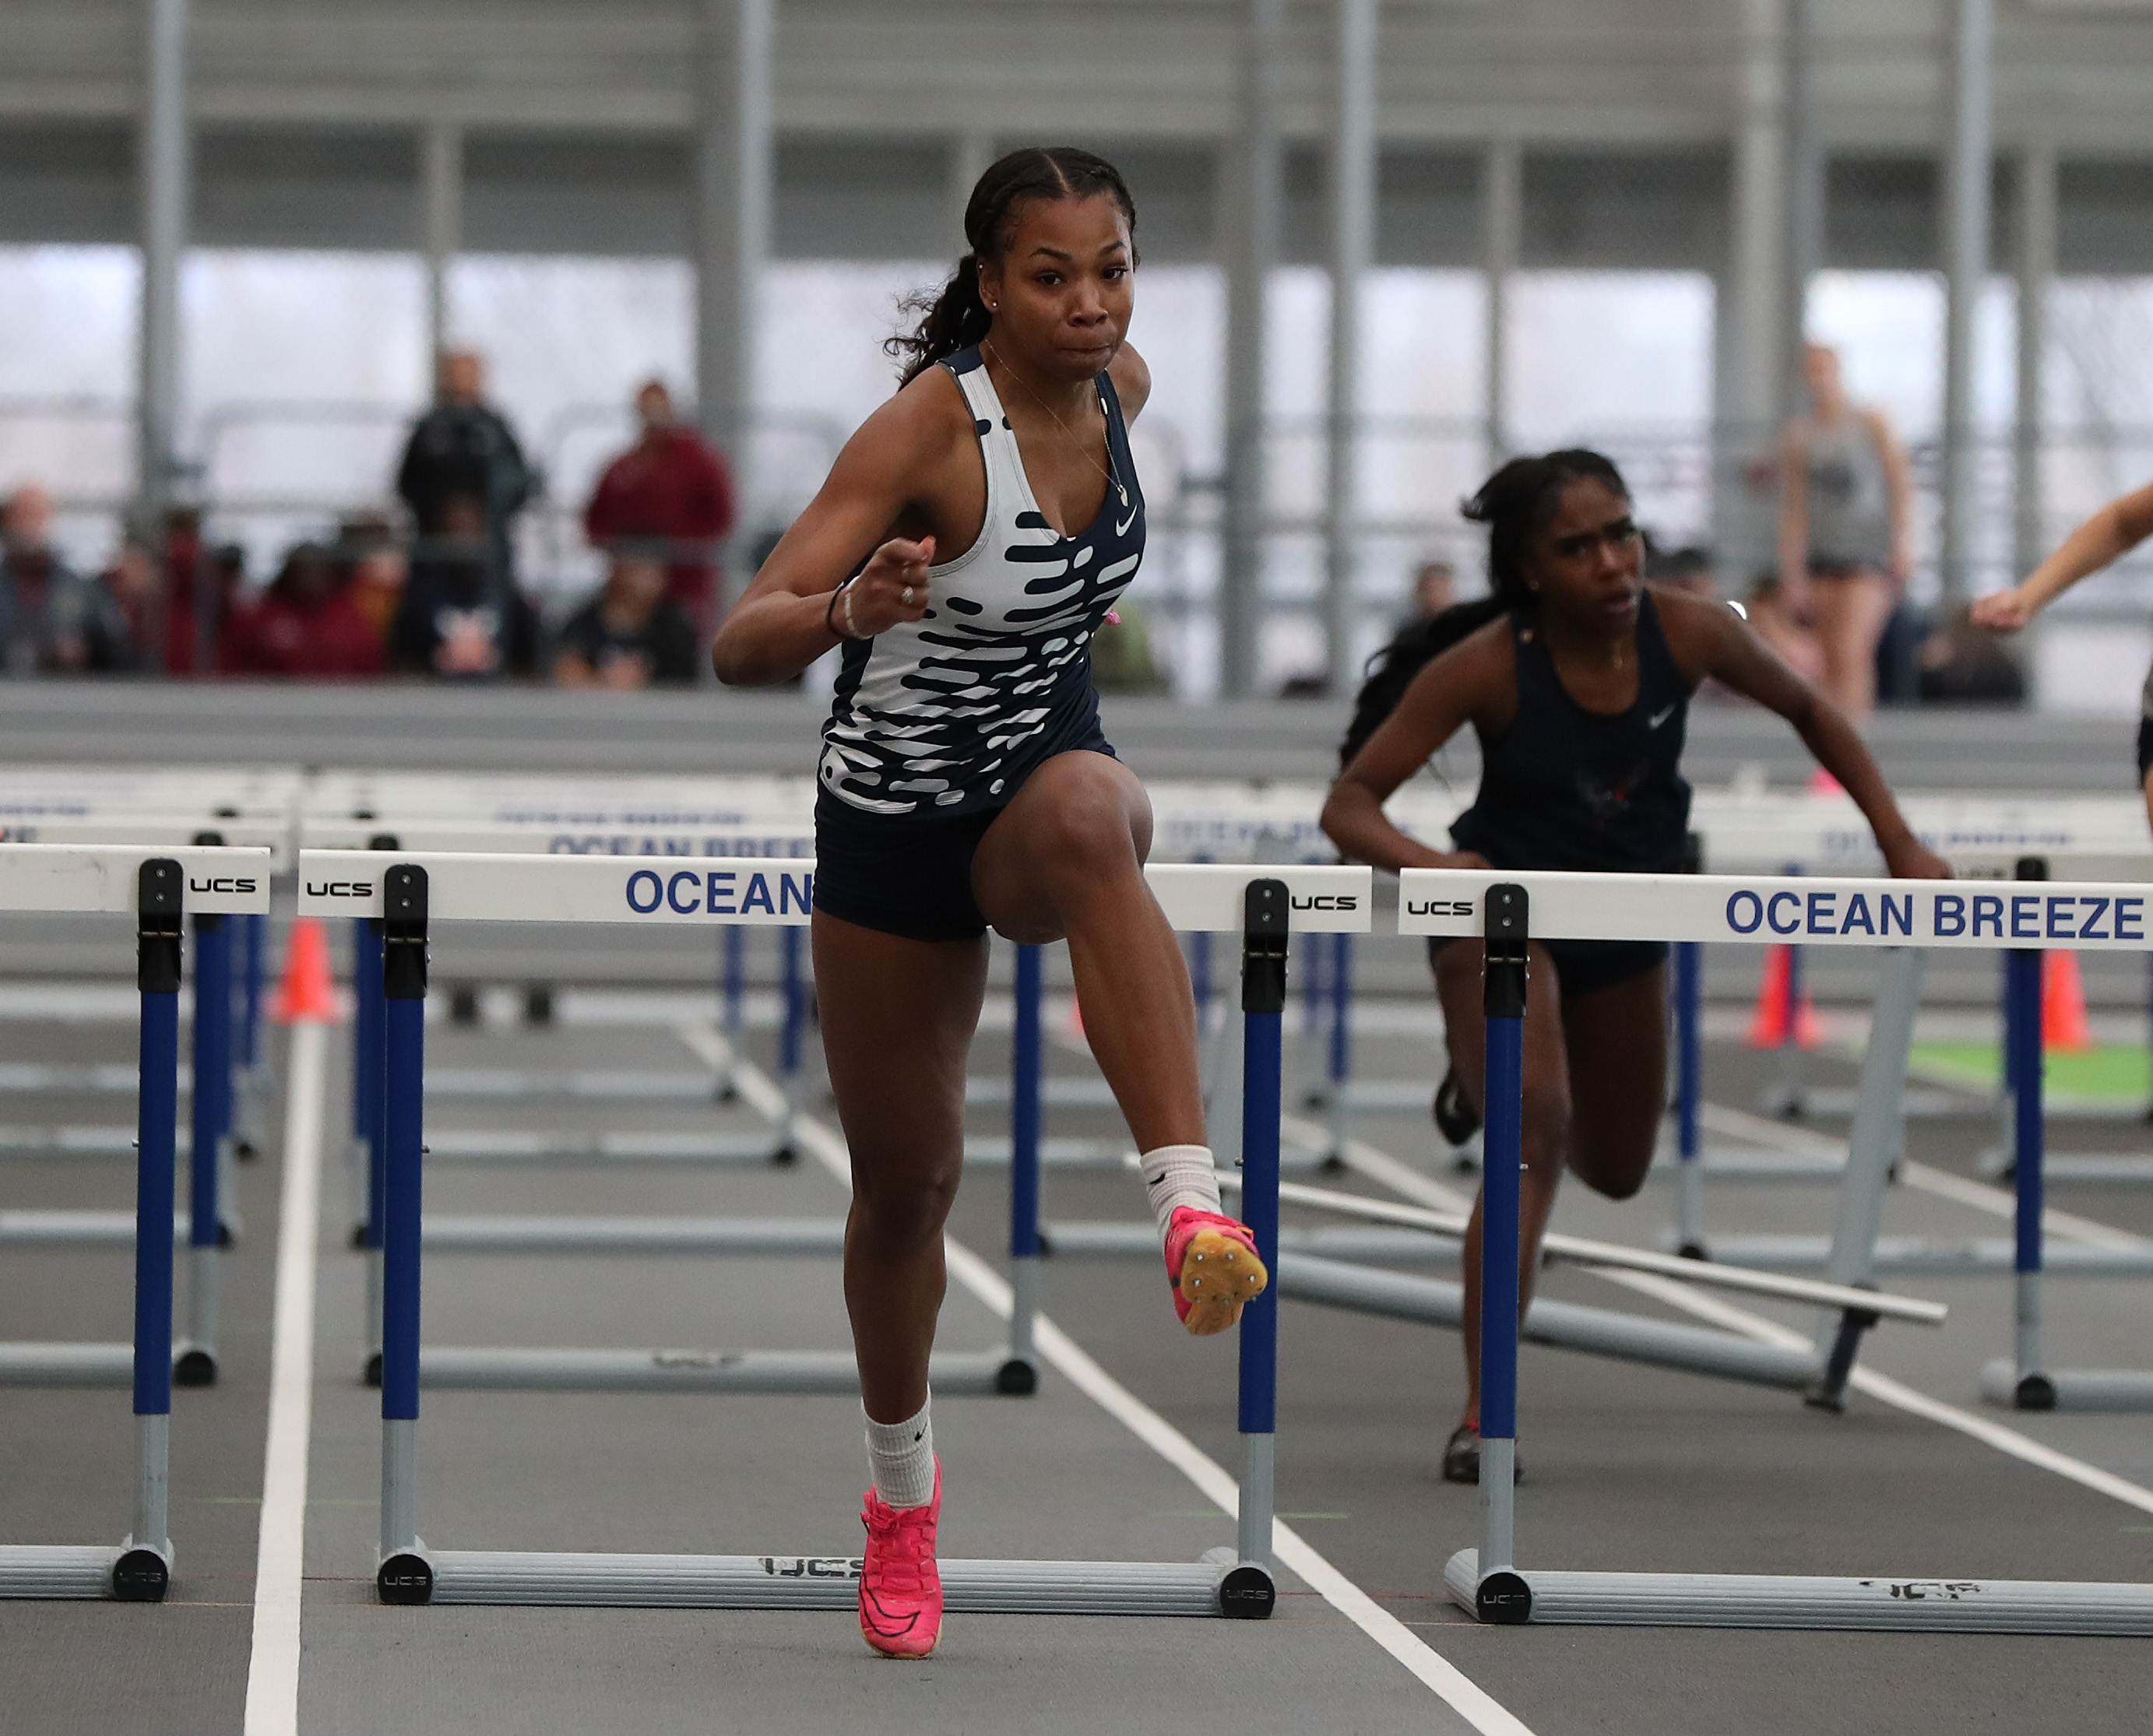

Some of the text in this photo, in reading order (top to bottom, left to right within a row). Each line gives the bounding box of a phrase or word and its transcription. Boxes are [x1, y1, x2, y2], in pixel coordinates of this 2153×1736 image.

[190, 878, 256, 893] UCS
[307, 882, 373, 897] UCS
[625, 870, 812, 915] OCEAN
[1291, 895, 1357, 910] UCS
[1408, 901, 1473, 915] UCS
[1726, 890, 2145, 940] OCEAN BREEZE
